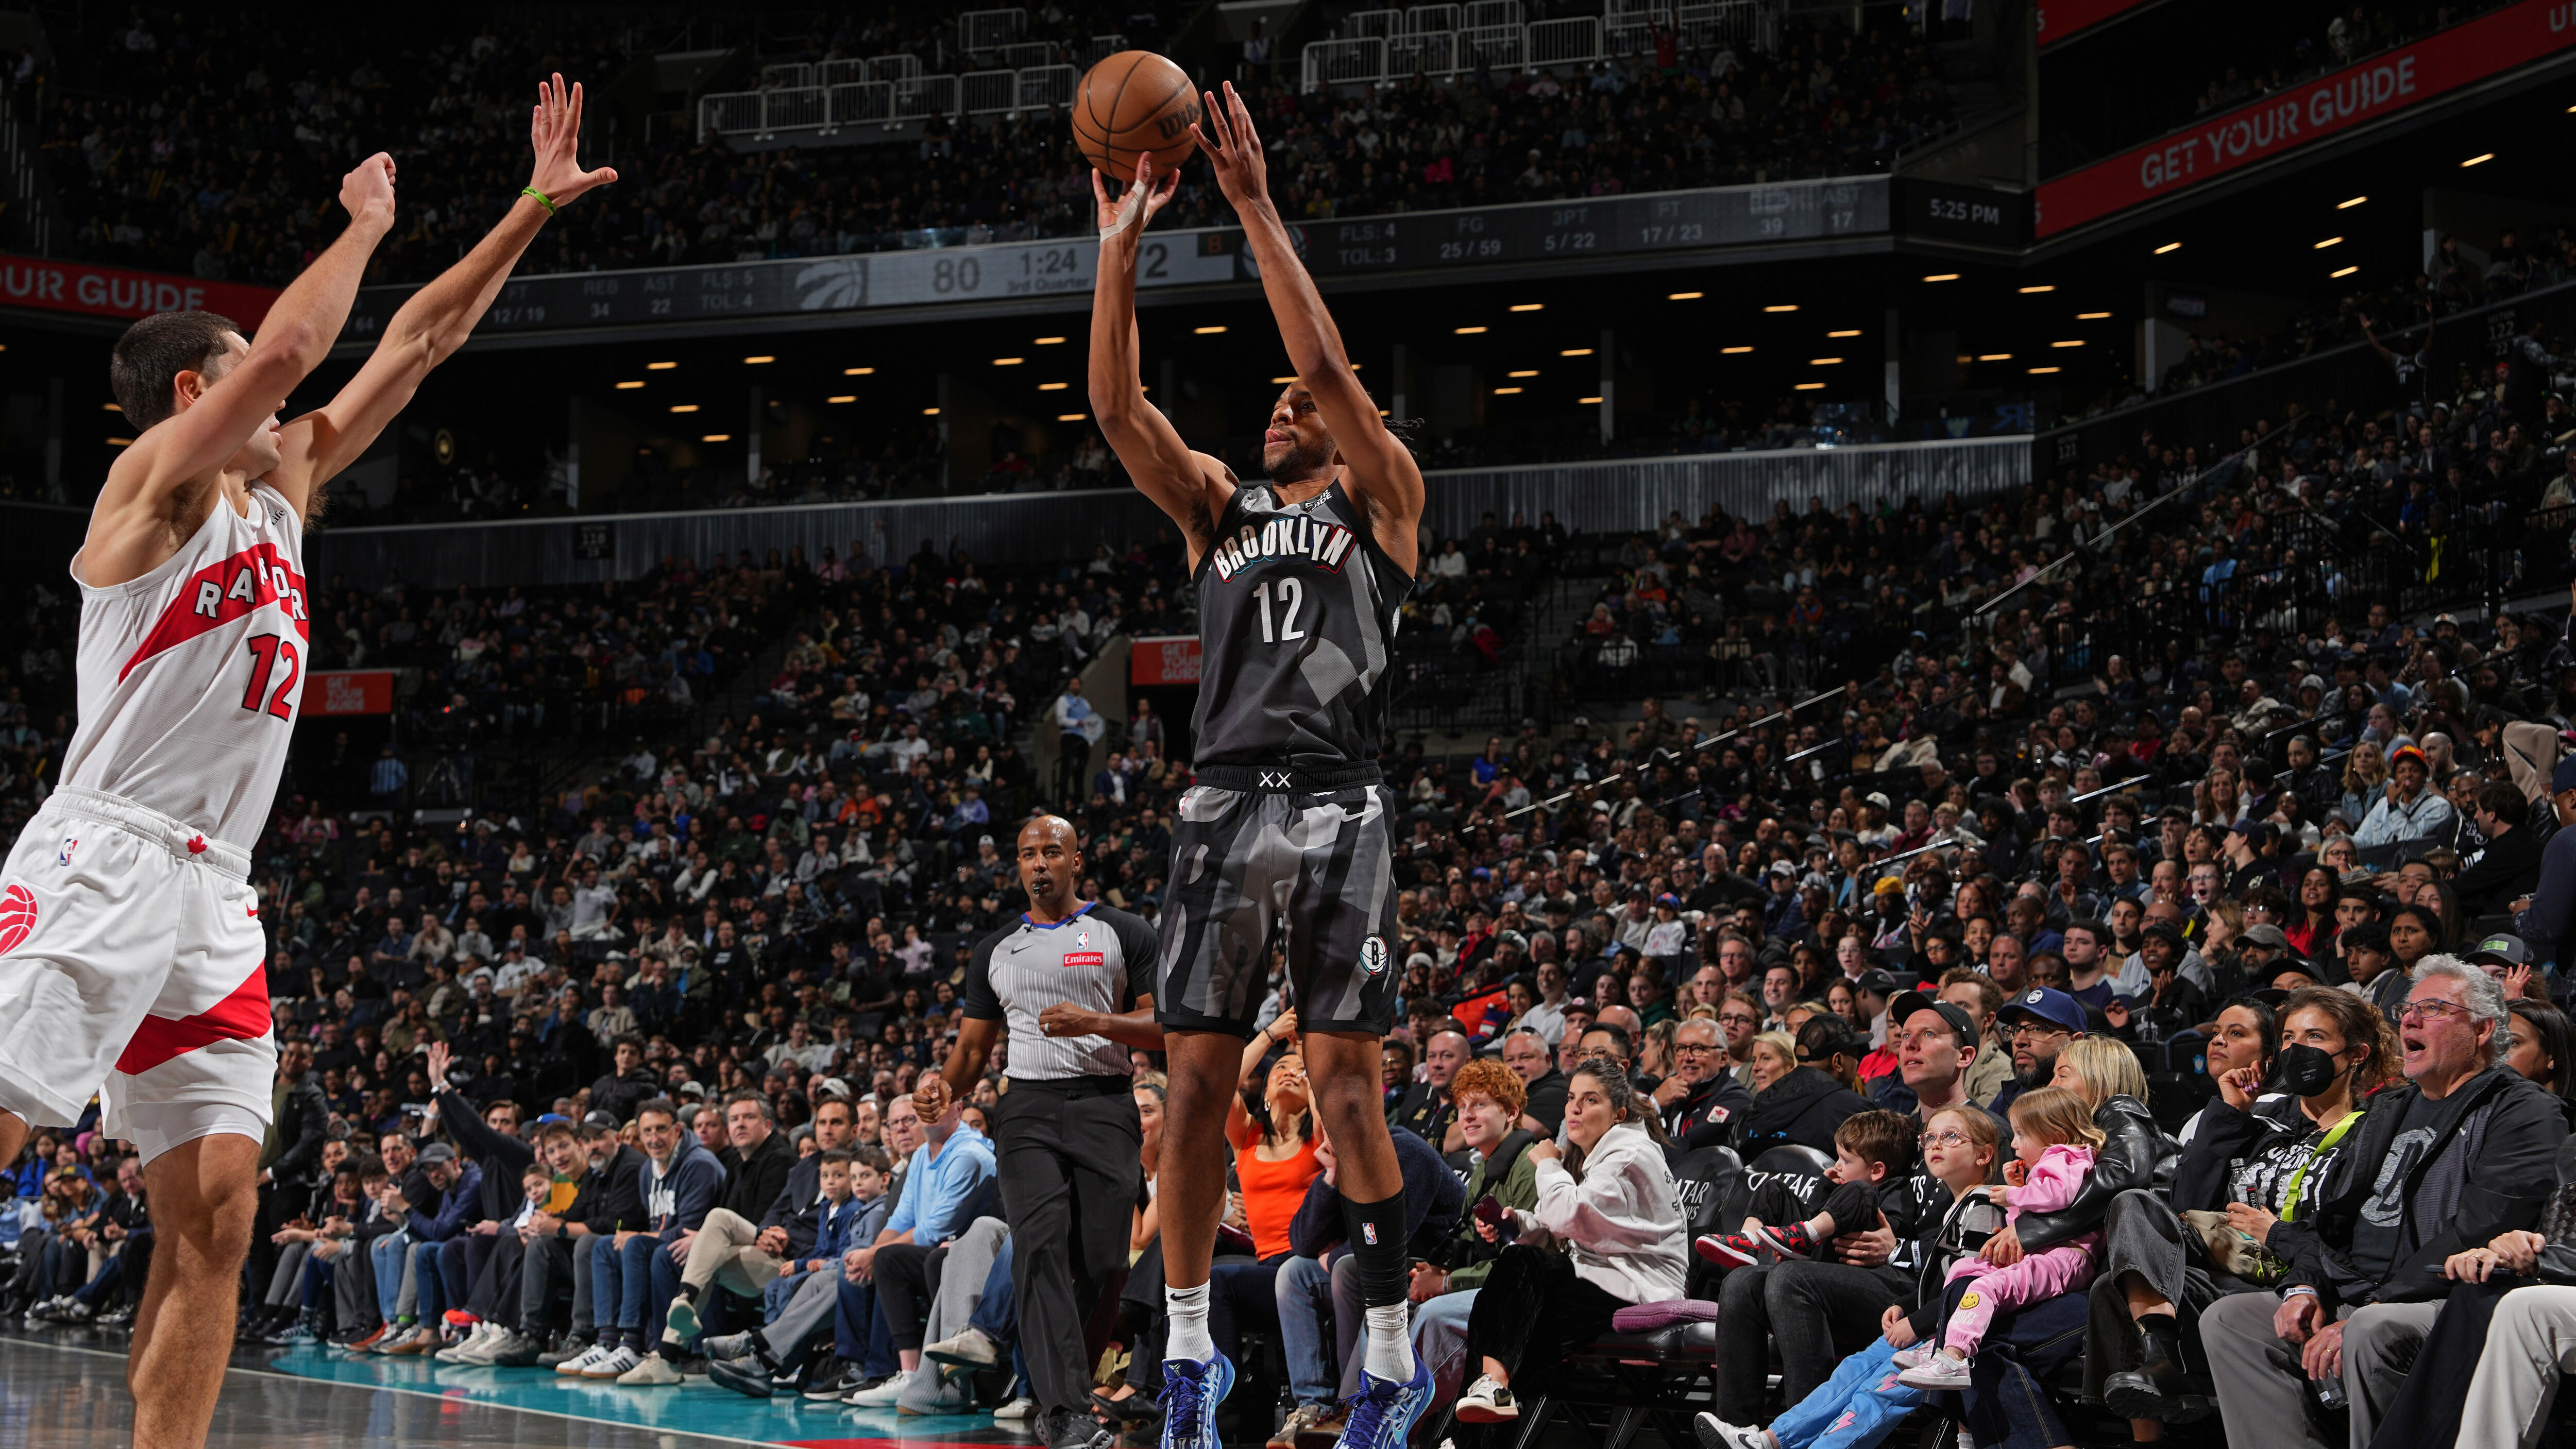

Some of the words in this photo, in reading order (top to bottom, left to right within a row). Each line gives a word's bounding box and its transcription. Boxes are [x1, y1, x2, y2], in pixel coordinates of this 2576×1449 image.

[2141, 138, 2198, 189] GET
[2207, 101, 2300, 163] YOUR
[2309, 56, 2416, 128] GUIDE
[1458, 216, 1484, 234] FG
[1552, 208, 1587, 227] 3PT
[1658, 201, 1680, 217] FT
[1760, 217, 1783, 234] 39
[1831, 212, 1853, 228] 17
[1930, 199, 1967, 221] 5:25
[1972, 204, 1999, 226] PM
[1384, 222, 1396, 237] 4
[1641, 227, 1663, 244] 17
[1680, 224, 1702, 241] 23
[1441, 241, 1462, 259] 25
[1479, 237, 1502, 256] 59
[1546, 235, 1555, 252] 5
[1572, 232, 1595, 249] 22
[1020, 248, 1077, 277] 1:24
[1384, 247, 1396, 263] 3
[933, 256, 980, 294] 80
[1035, 277, 1090, 292] Quarter
[0, 264, 65, 301] UR
[78, 275, 204, 310] GUIDE
[591, 302, 609, 318] 34
[651, 298, 671, 315] 22
[743, 293, 753, 309] 4
[493, 308, 512, 324] 12
[2489, 320, 2514, 342] 122
[1213, 516, 1353, 581] BROOKLYN
[1252, 576, 1305, 643] 12
[241, 632, 299, 722] 12
[1064, 953, 1103, 965] Emirates
[1370, 940, 1380, 966] B
[1674, 1178, 1710, 1204] ATAR
[1748, 1172, 1818, 1204] QTAR
[2249, 1192, 2258, 1209] entia
